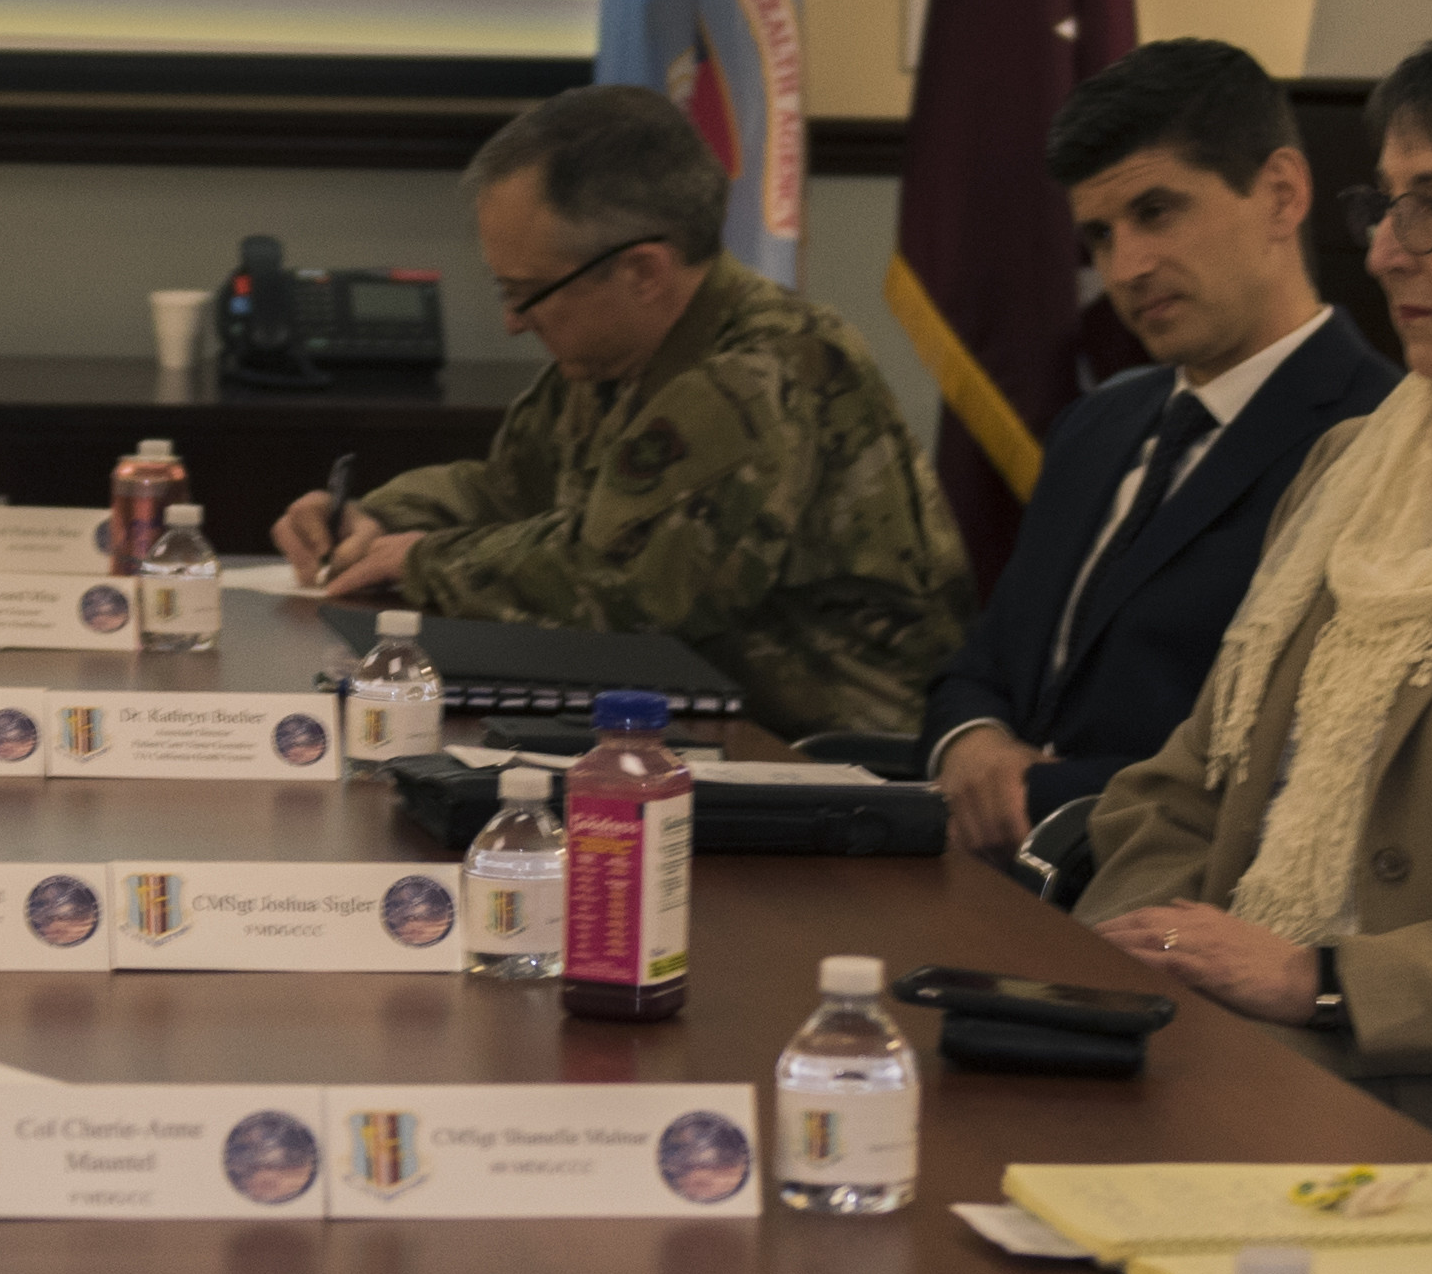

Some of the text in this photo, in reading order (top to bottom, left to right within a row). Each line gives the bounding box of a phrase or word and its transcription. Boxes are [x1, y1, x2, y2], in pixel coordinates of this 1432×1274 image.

[119, 708, 144, 723] Dr.
[192, 894, 377, 917] CMSgt Joshua Sigler
[14, 1116, 58, 1140] Col
